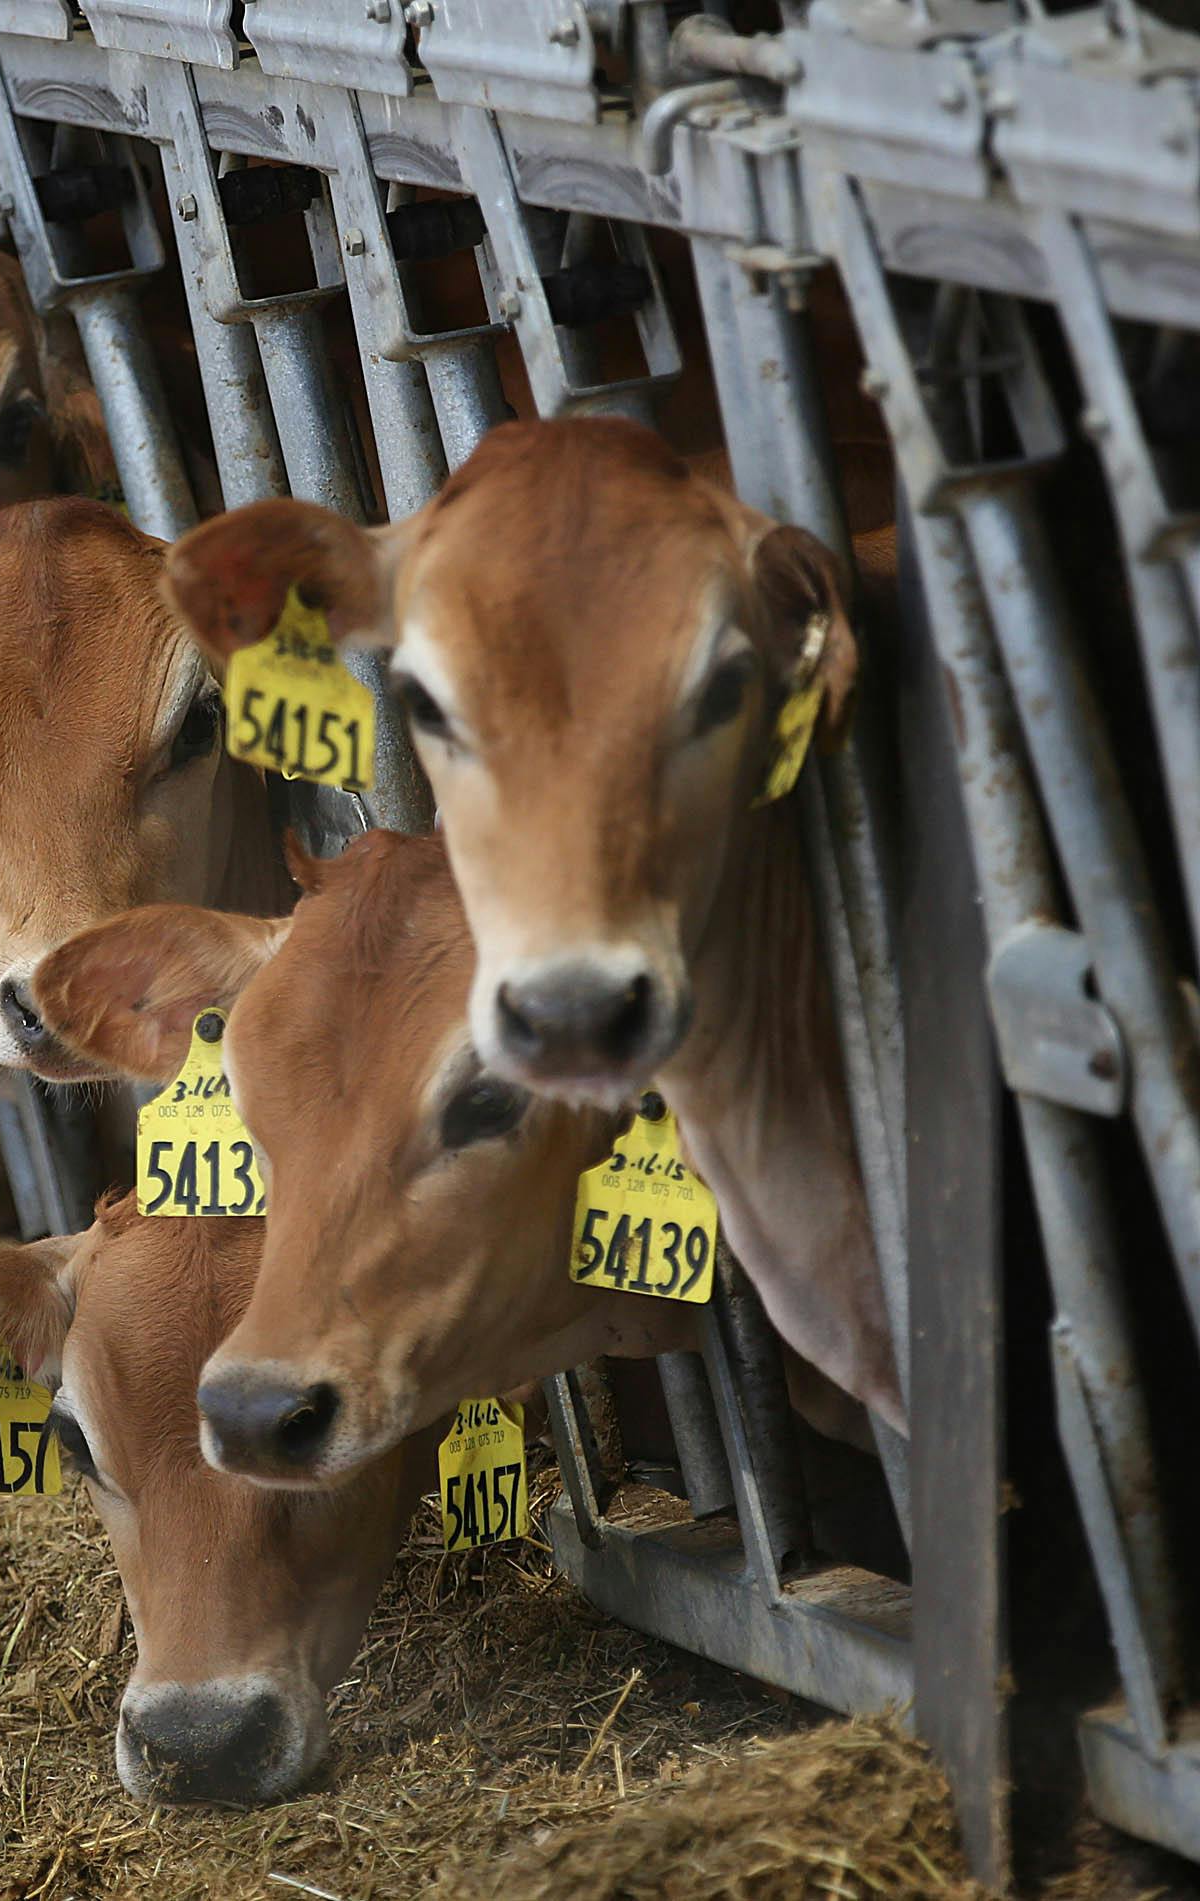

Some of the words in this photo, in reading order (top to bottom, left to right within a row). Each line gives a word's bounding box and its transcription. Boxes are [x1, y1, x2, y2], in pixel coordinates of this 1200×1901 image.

[242, 687, 367, 788] 54151
[158, 1105, 177, 1118] 003
[185, 1104, 205, 1118] 128
[211, 1104, 231, 1117] 075
[146, 1141, 266, 1216] 5413
[651, 1182, 671, 1197] 075
[676, 1185, 695, 1200] 701
[576, 1208, 710, 1298] 54139
[446, 1461, 522, 1550] 54157
